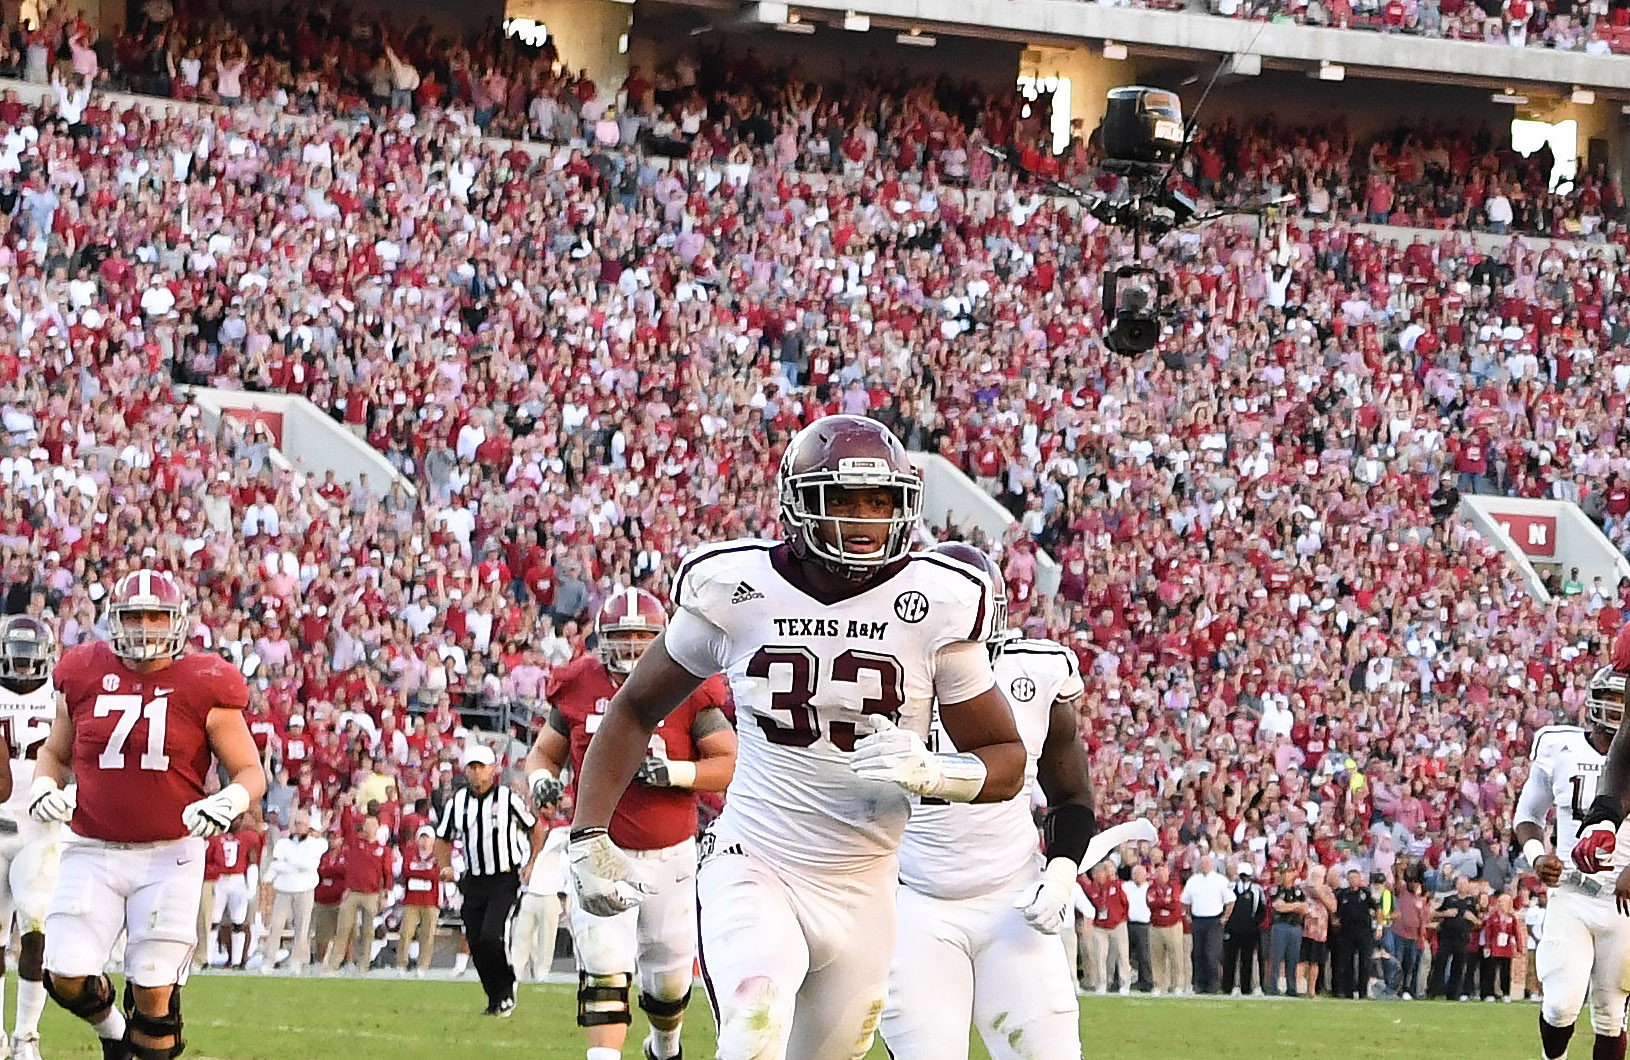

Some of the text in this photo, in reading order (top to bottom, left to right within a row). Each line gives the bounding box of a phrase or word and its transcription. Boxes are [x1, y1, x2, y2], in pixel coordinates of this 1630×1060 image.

[731, 591, 766, 605] adidas
[894, 591, 930, 623] SEC
[774, 619, 888, 640] TEXAS A&M
[746, 645, 905, 753] 33
[1011, 677, 1036, 702] SEC
[94, 695, 169, 771] 71
